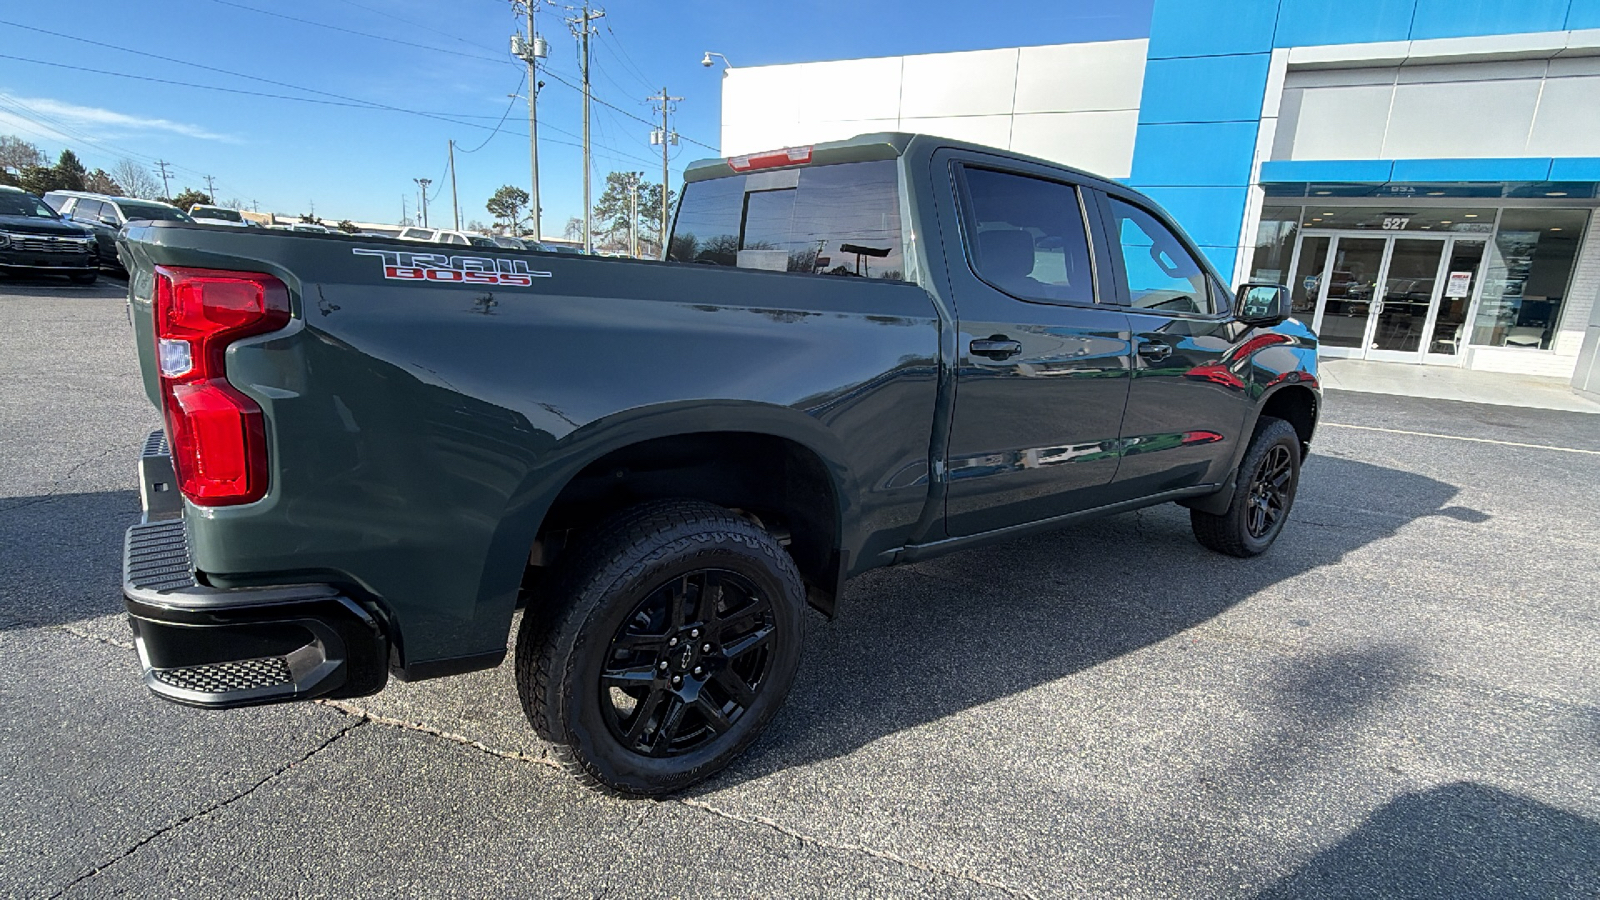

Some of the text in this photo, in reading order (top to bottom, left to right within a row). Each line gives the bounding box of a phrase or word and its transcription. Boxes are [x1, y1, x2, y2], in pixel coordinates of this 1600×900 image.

[1382, 218, 1410, 230] 527
[352, 248, 552, 277] TRAIL
[384, 265, 532, 287] BOSS
